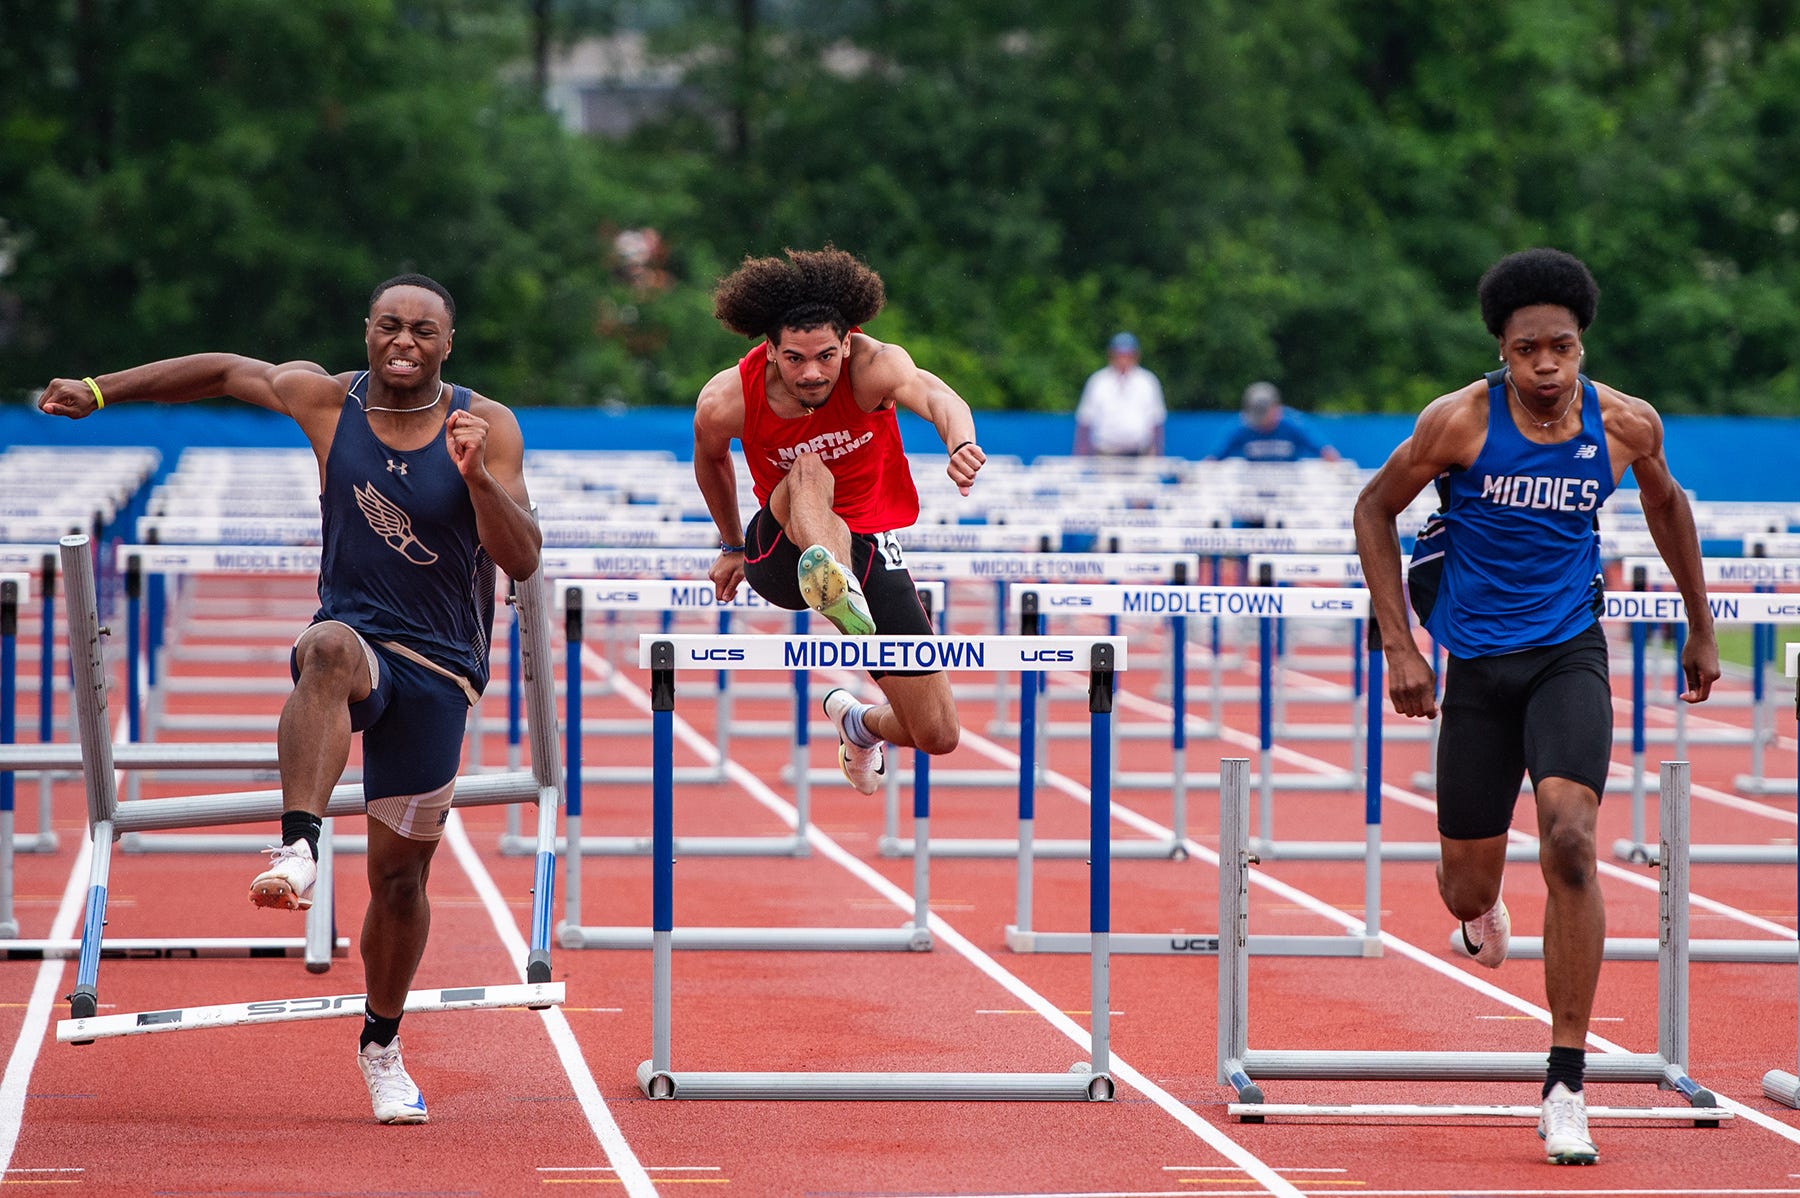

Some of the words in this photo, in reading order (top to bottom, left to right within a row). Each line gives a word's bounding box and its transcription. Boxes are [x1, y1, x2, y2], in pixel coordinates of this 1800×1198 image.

[778, 430, 852, 460] NORTH
[1480, 474, 1599, 512] MIDDIES
[597, 591, 639, 601] UCS
[1050, 595, 1093, 606] UCS
[1122, 591, 1284, 614] MIDDLETOWN
[1311, 599, 1354, 610] UCS
[691, 648, 745, 661] UCS
[784, 641, 985, 668] MIDDLETOWN
[1020, 649, 1074, 662] UCS
[1170, 938, 1219, 951] UCS
